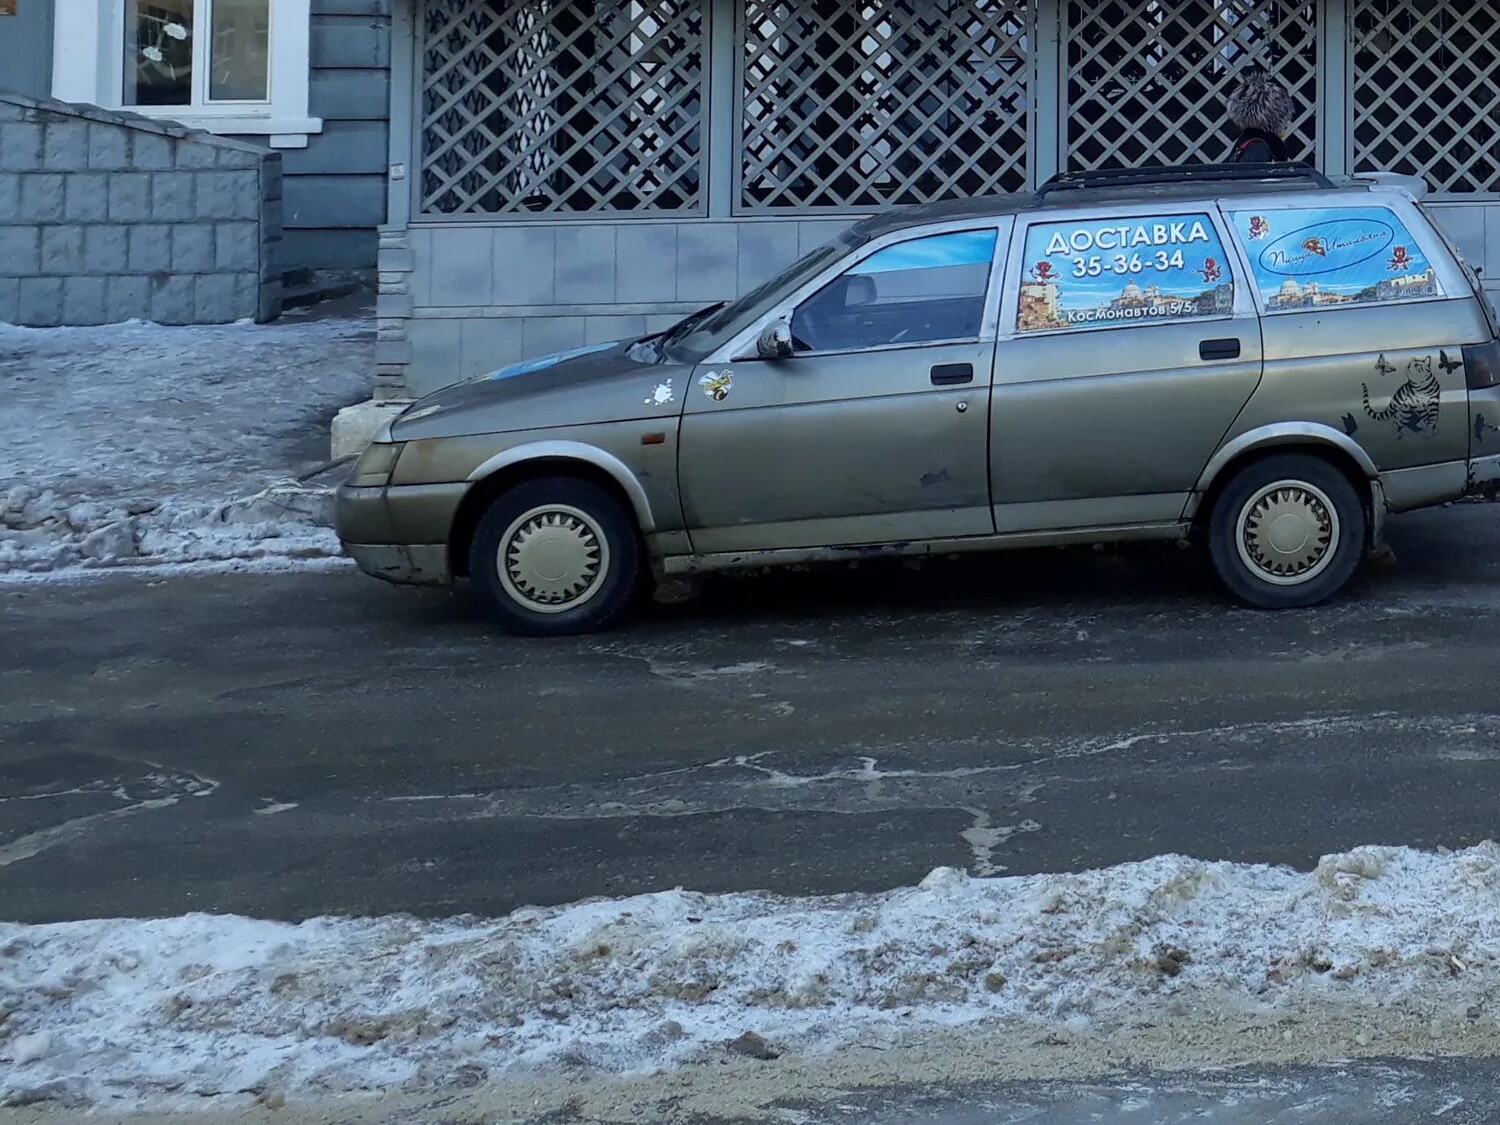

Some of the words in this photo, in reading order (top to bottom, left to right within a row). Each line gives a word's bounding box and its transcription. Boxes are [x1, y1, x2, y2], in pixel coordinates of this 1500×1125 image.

[1045, 220, 1209, 256] ДОСТАВКА
[1071, 249, 1184, 277] 35-36-34
[1067, 305, 1166, 323] Космонавтов
[1169, 300, 1193, 315] 5/5
